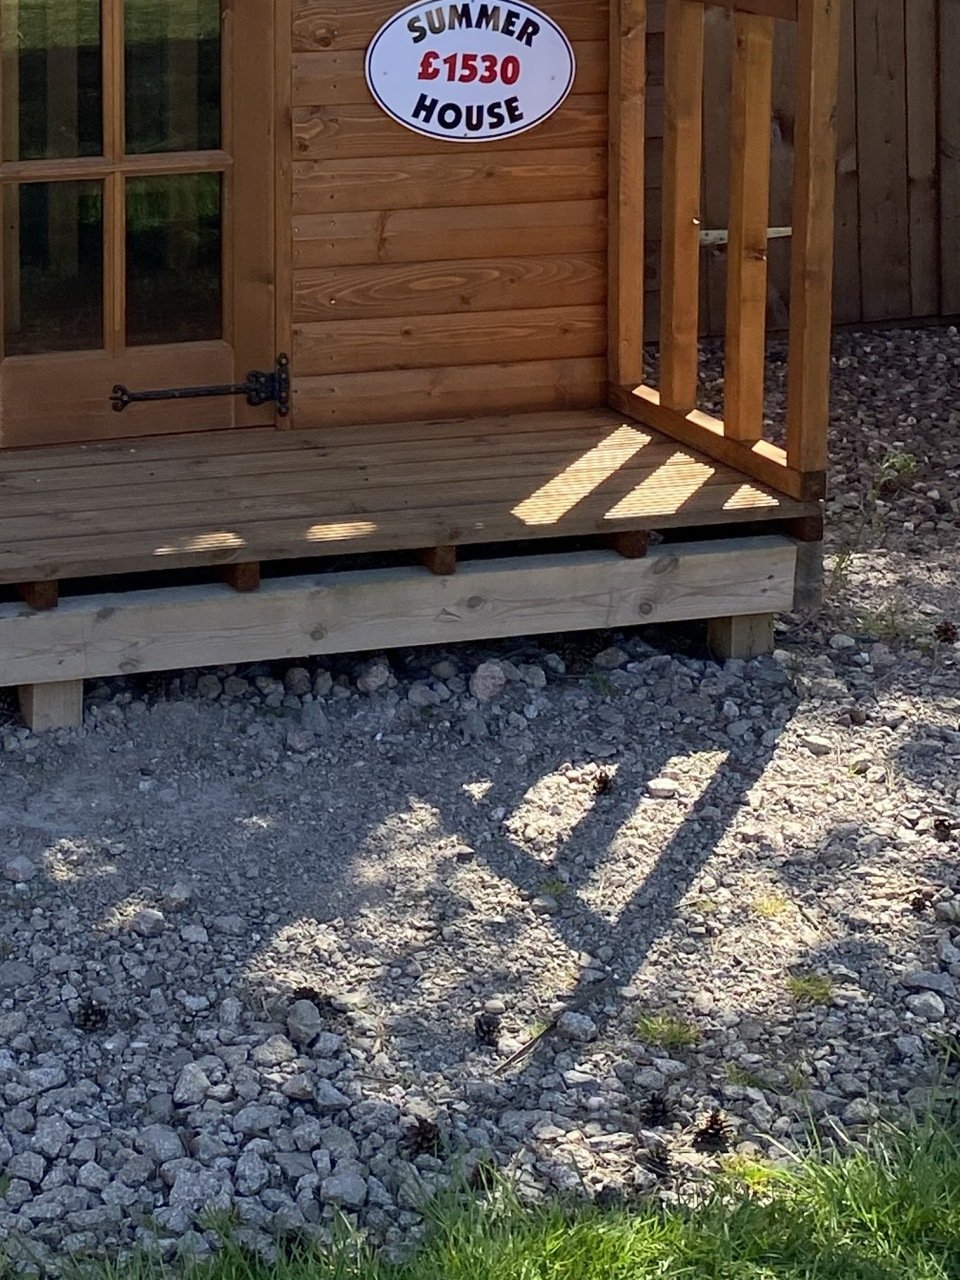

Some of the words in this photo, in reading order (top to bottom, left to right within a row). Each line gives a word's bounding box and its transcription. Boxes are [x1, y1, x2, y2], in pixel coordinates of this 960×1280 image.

[407, 3, 540, 48] SUMMER
[417, 50, 521, 86] £1530
[411, 92, 524, 132] HOUSE
